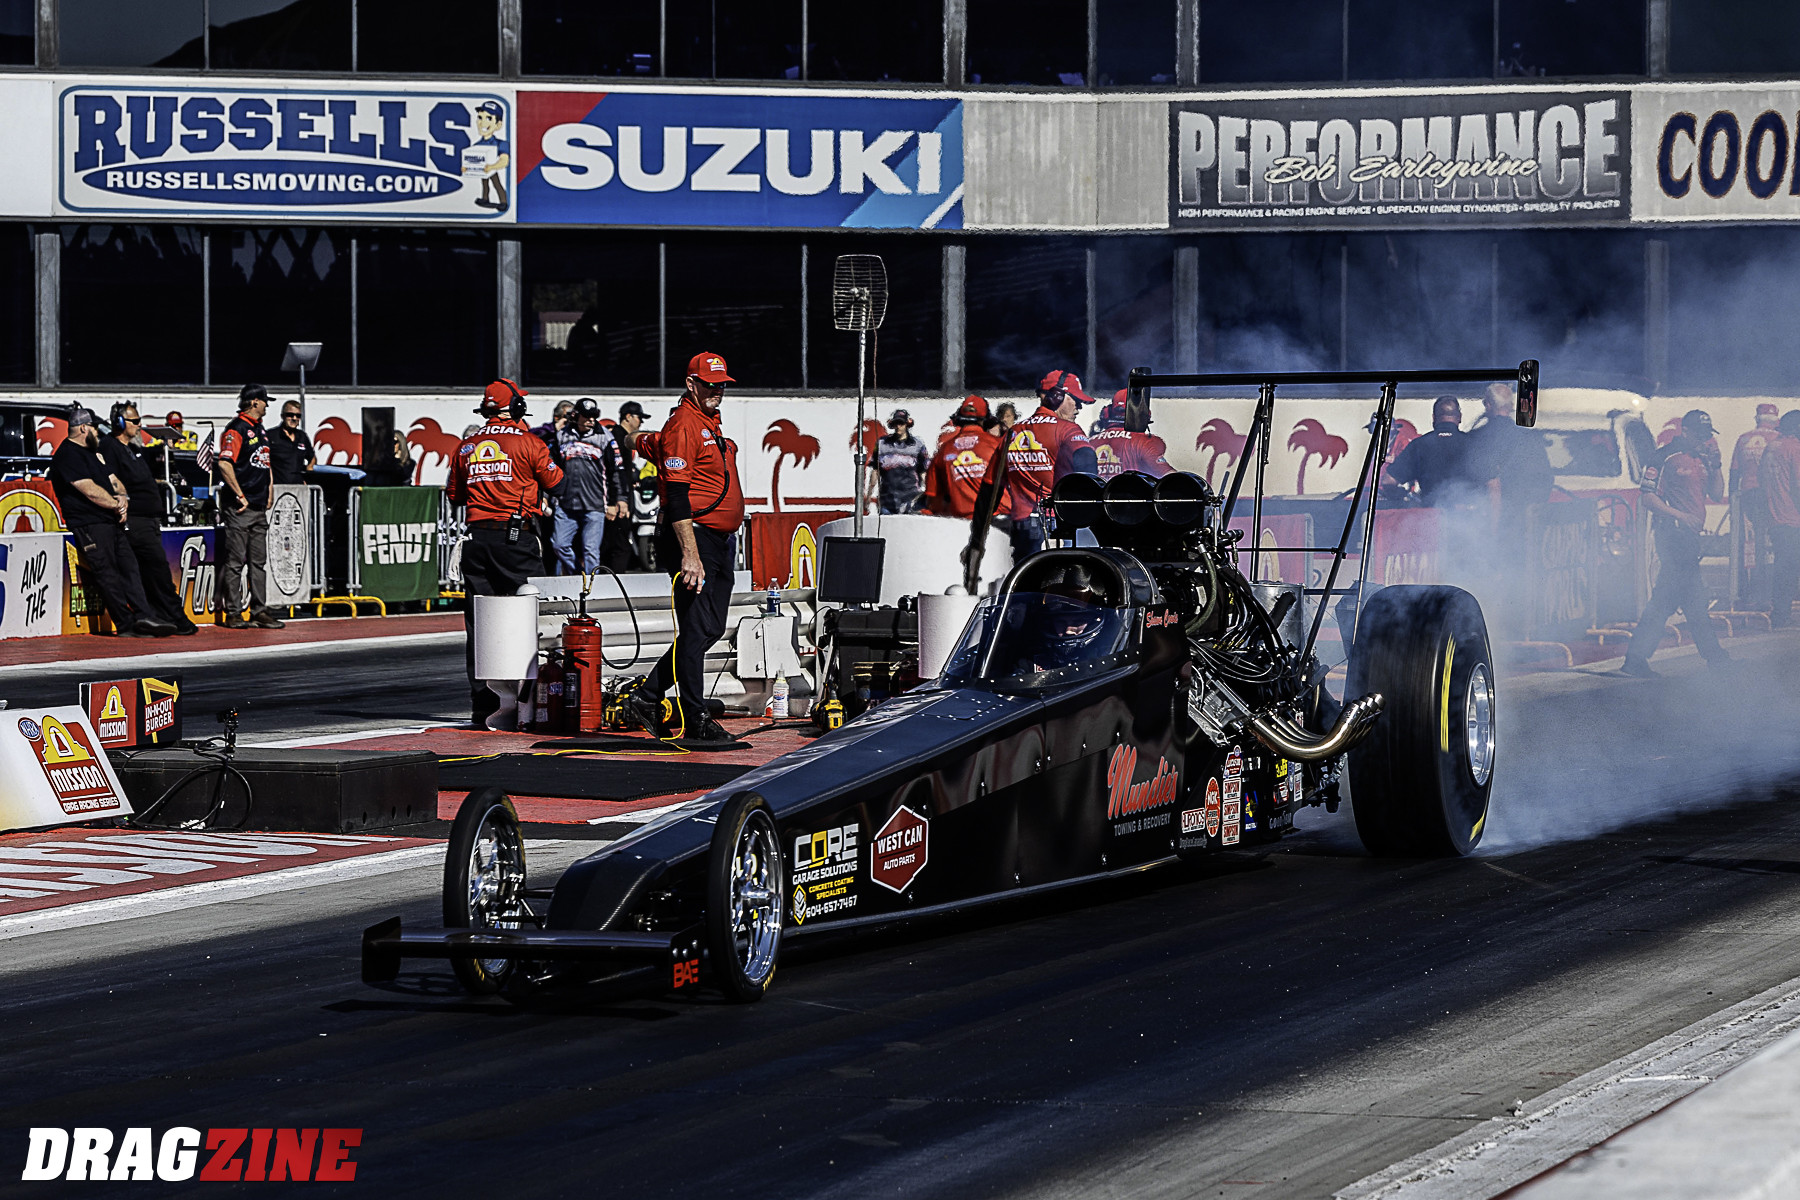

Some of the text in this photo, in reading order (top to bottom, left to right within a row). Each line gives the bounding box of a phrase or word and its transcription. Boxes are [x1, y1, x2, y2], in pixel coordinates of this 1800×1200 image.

[74, 95, 471, 176] RUSSELLS
[540, 122, 942, 195] SUZUKI
[1178, 99, 1621, 204] PERFORMANCE
[1657, 110, 1800, 199] COO
[106, 171, 439, 194] RUSSELLSMOVING.COM
[1264, 151, 1540, 189] Bob Earleywine
[1178, 209, 1200, 218] HIGH
[1202, 208, 1264, 218] PERFORMANCE
[1273, 208, 1304, 217] RACING
[1305, 207, 1336, 216] ENGINE
[1337, 206, 1372, 216] SERVICE
[1377, 204, 1429, 214] SUPERFLOW
[1430, 204, 1461, 214] ENGINE
[665, 458, 685, 468] NHRA
[362, 523, 437, 565] FENDT
[21, 550, 47, 594] AND
[26, 584, 48, 627] THE
[145, 698, 173, 719] IN-N-OUT
[100, 721, 126, 737] MISSION
[145, 711, 173, 733] BURGER
[50, 765, 106, 793] MISSION
[1108, 743, 1178, 820] Mundie's
[63, 796, 119, 812] DRAG RACING SERIES
[1207, 791, 1218, 805] NGK
[1114, 820, 1136, 836] TOWING
[1138, 819, 1142, 831] &
[1143, 812, 1171, 830] RECOVERY
[794, 823, 859, 869] CORE
[877, 825, 923, 854] WEST CAN
[793, 860, 857, 885] GARAGE SOLUTIONS
[883, 853, 916, 871] AUTO PARTS
[809, 881, 833, 893] CONCRETE
[816, 886, 847, 900] SPECIALISTS
[673, 958, 699, 988] BAE
